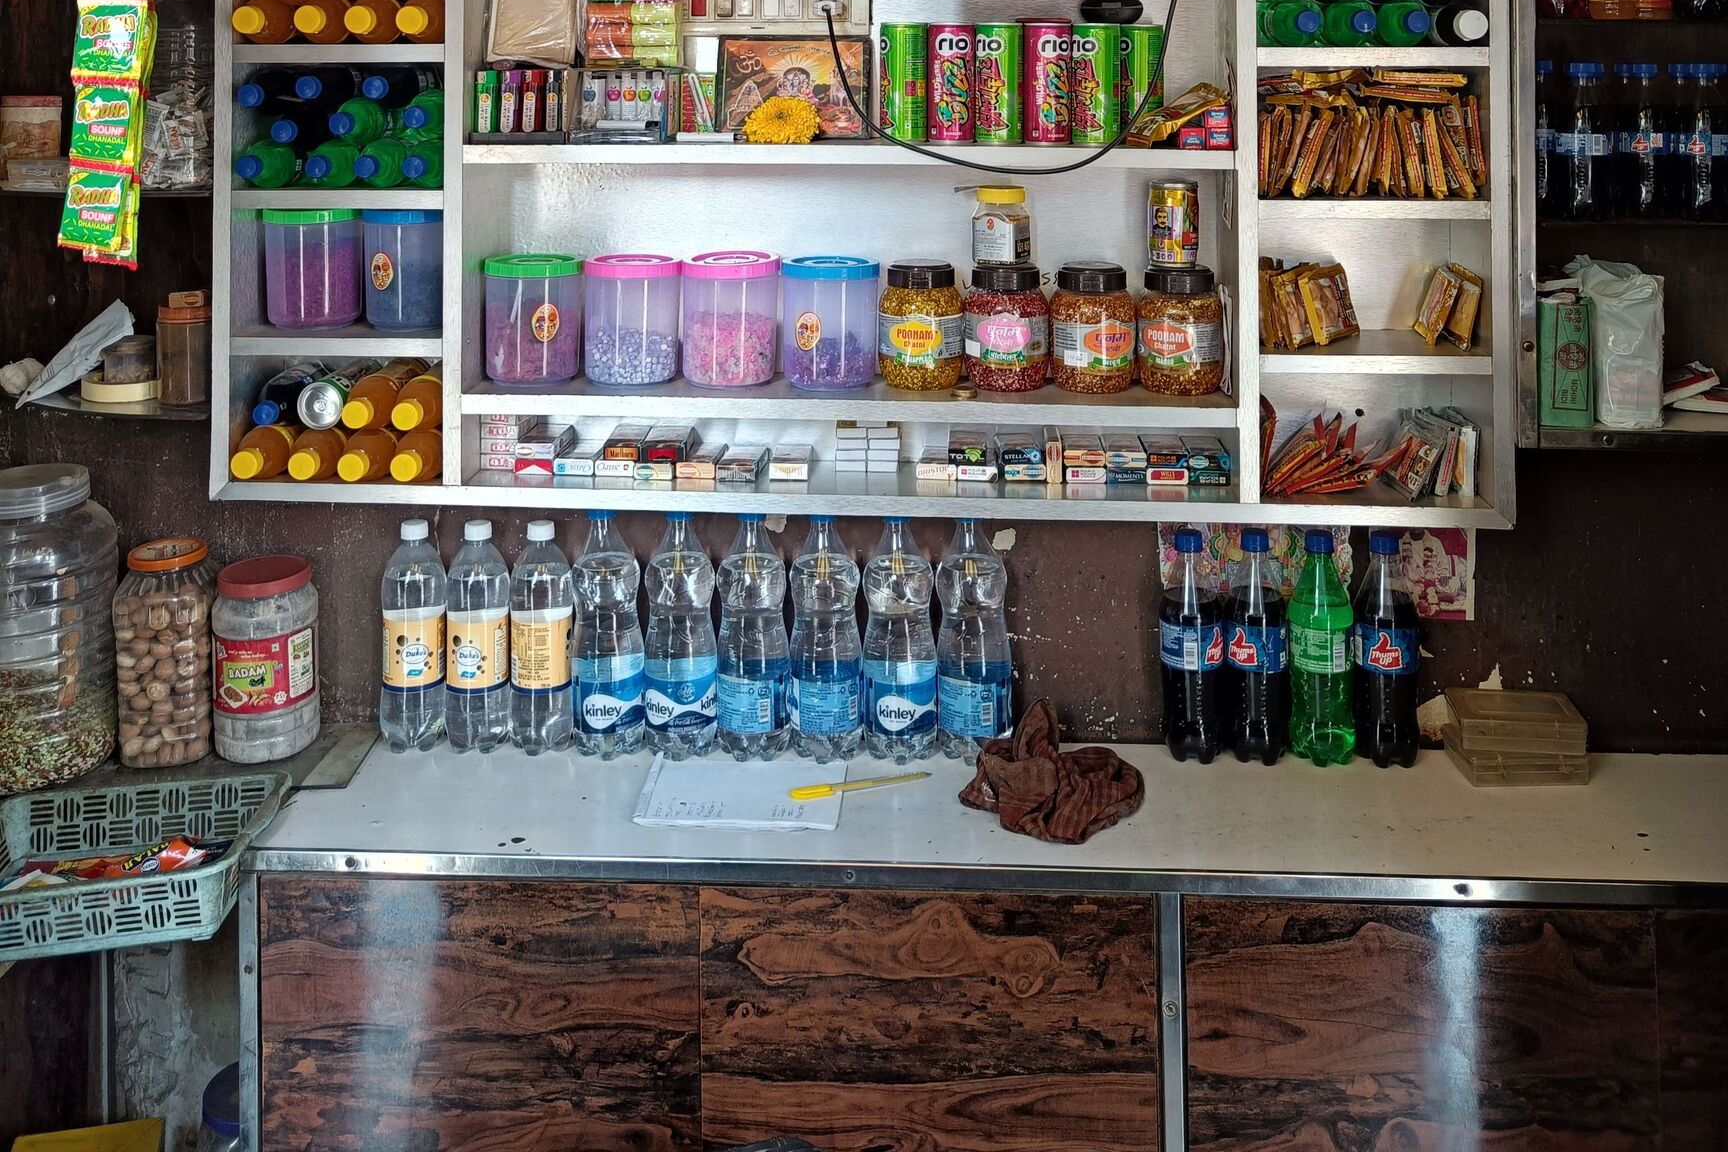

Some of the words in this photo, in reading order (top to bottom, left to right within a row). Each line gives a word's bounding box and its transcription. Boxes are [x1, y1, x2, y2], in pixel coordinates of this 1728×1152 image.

[939, 38, 968, 51] rio
[68, 186, 121, 206] RADHA
[81, 210, 115, 223] SOUNF
[77, 220, 115, 232] DHANADAL
[896, 328, 934, 340] POONAM
[1148, 329, 1185, 343] POONAM
[1570, 379, 1578, 405] MOHINI
[609, 449, 634, 459] Marlboro
[405, 650, 427, 659] Duke's
[458, 651, 480, 660] Duke's
[1230, 647, 1254, 656] Thums
[1372, 650, 1399, 660] Thums
[229, 664, 267, 679] BADAM
[585, 704, 622, 718] kinley
[879, 705, 916, 722] kinley
